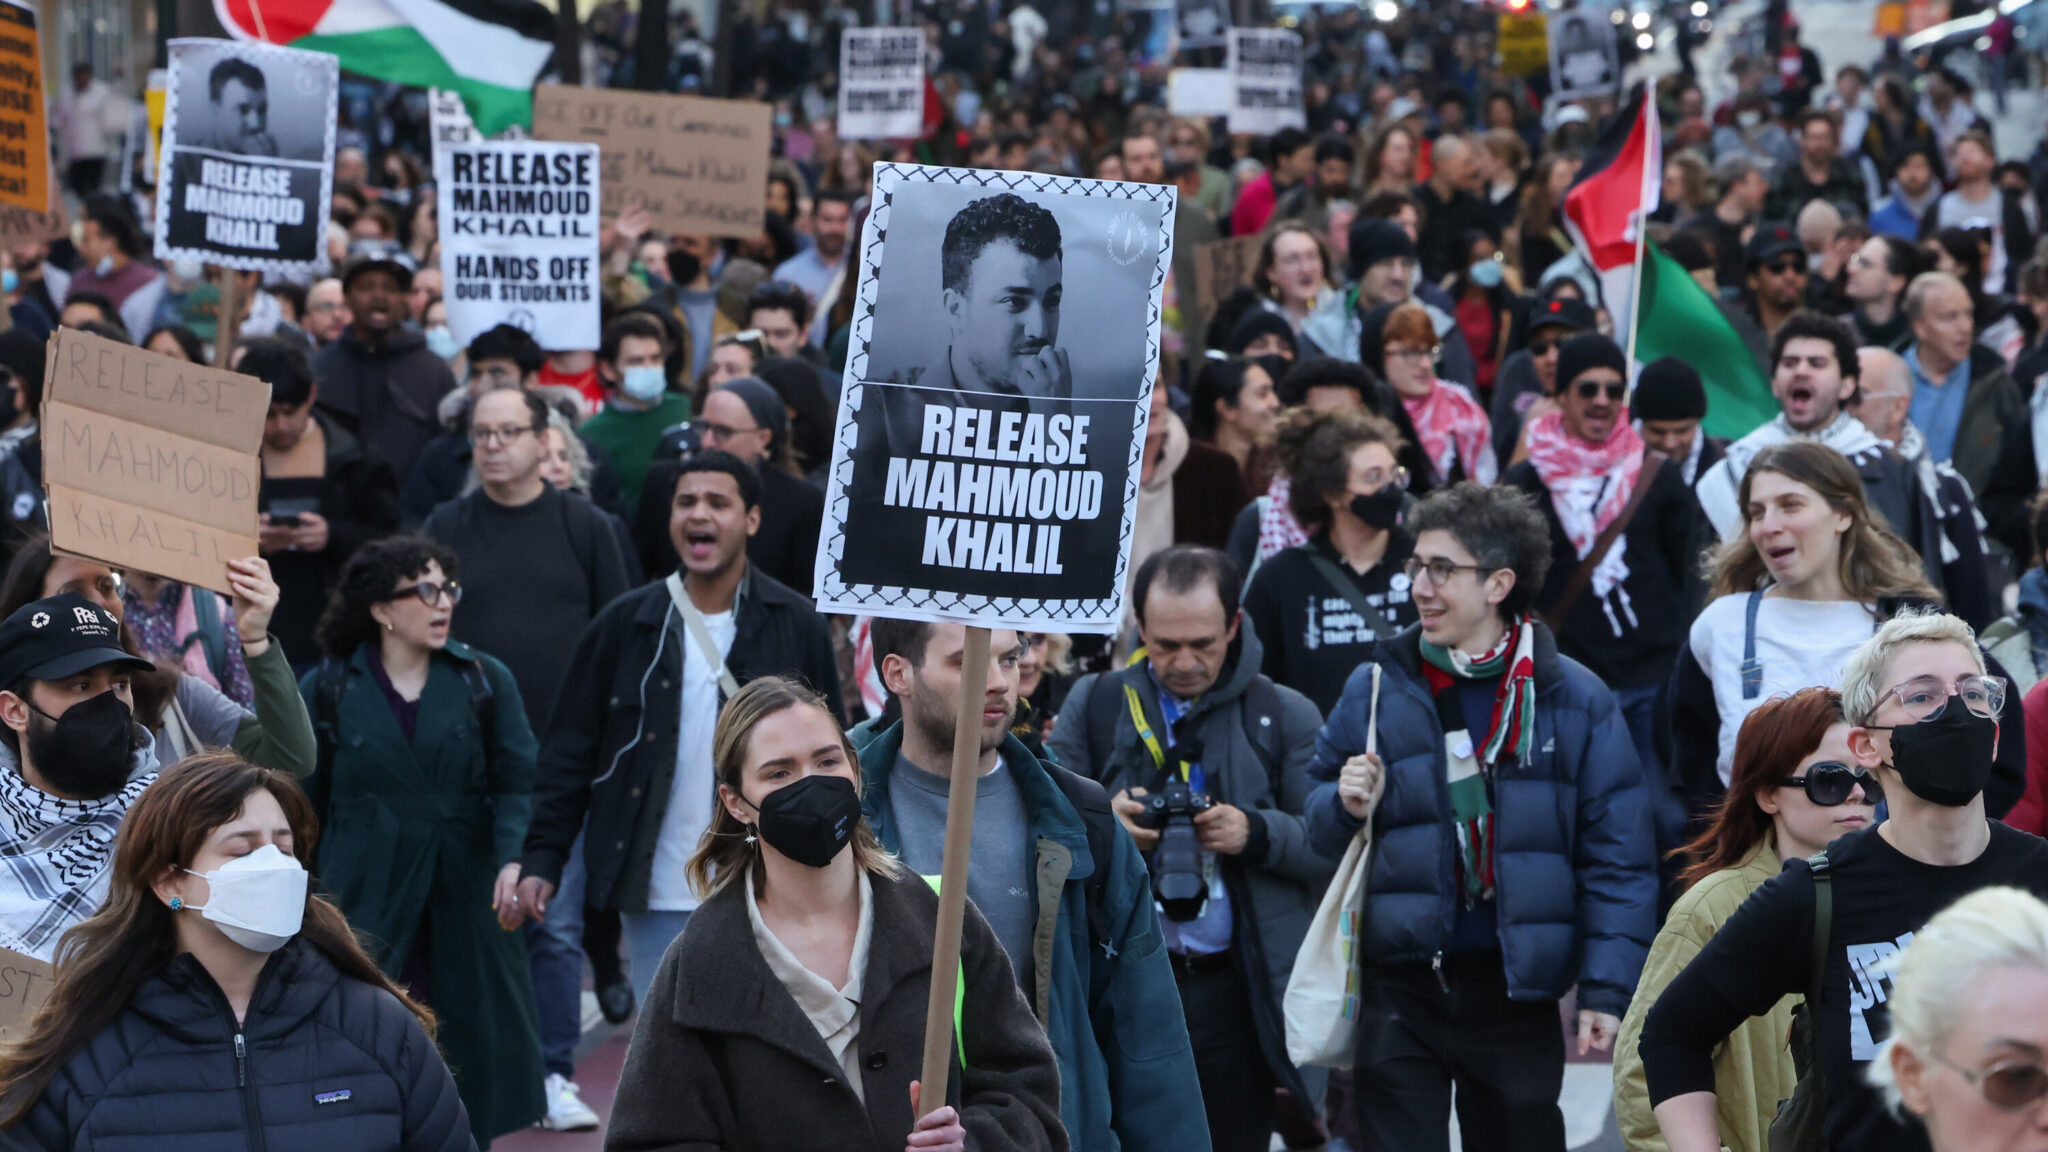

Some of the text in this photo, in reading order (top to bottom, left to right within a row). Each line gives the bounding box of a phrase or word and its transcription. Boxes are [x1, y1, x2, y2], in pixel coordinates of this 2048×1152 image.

[202, 158, 291, 196] RELEASE
[452, 152, 591, 186] RELEASE
[185, 184, 304, 225] MAHMOUD
[453, 189, 590, 215] MAHMOUD
[206, 216, 279, 250] KHALIL
[453, 217, 591, 238] KHALIL
[456, 255, 590, 281] HANDS OFF
[456, 284, 590, 302] OUR STUDENTS
[70, 342, 236, 413] RELEASE
[920, 404, 1091, 465] RELEASE
[62, 420, 250, 501] MAHMOUD
[884, 457, 1103, 520] MAHMOUD
[71, 501, 231, 563] KHALIL
[922, 516, 1063, 575] KHALIL
